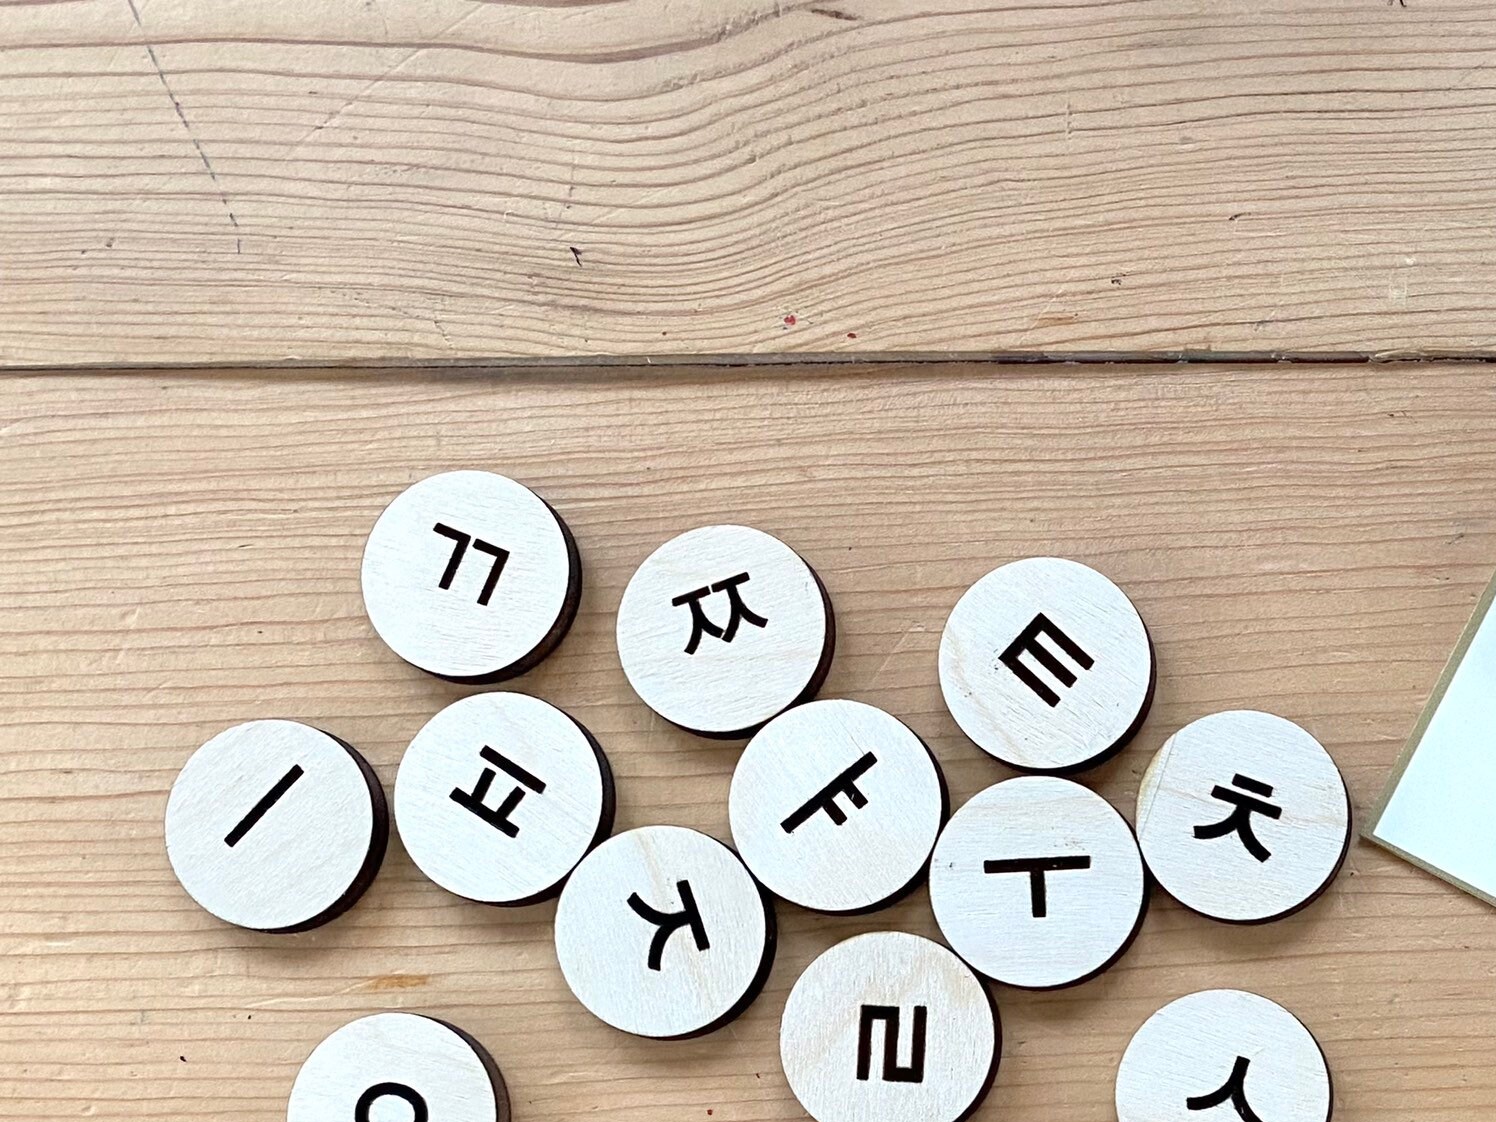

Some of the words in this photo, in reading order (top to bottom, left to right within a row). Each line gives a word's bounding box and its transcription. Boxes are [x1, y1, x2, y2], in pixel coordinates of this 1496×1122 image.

[433, 523, 510, 606] ㄲ
[672, 572, 768, 655] ㅉ
[998, 613, 1094, 707] ㅌ
[449, 745, 546, 838] ㅍ
[1194, 774, 1282, 862] ㅊ
[627, 880, 710, 971] ㅈ
[857, 1005, 927, 1083] ㄹ
